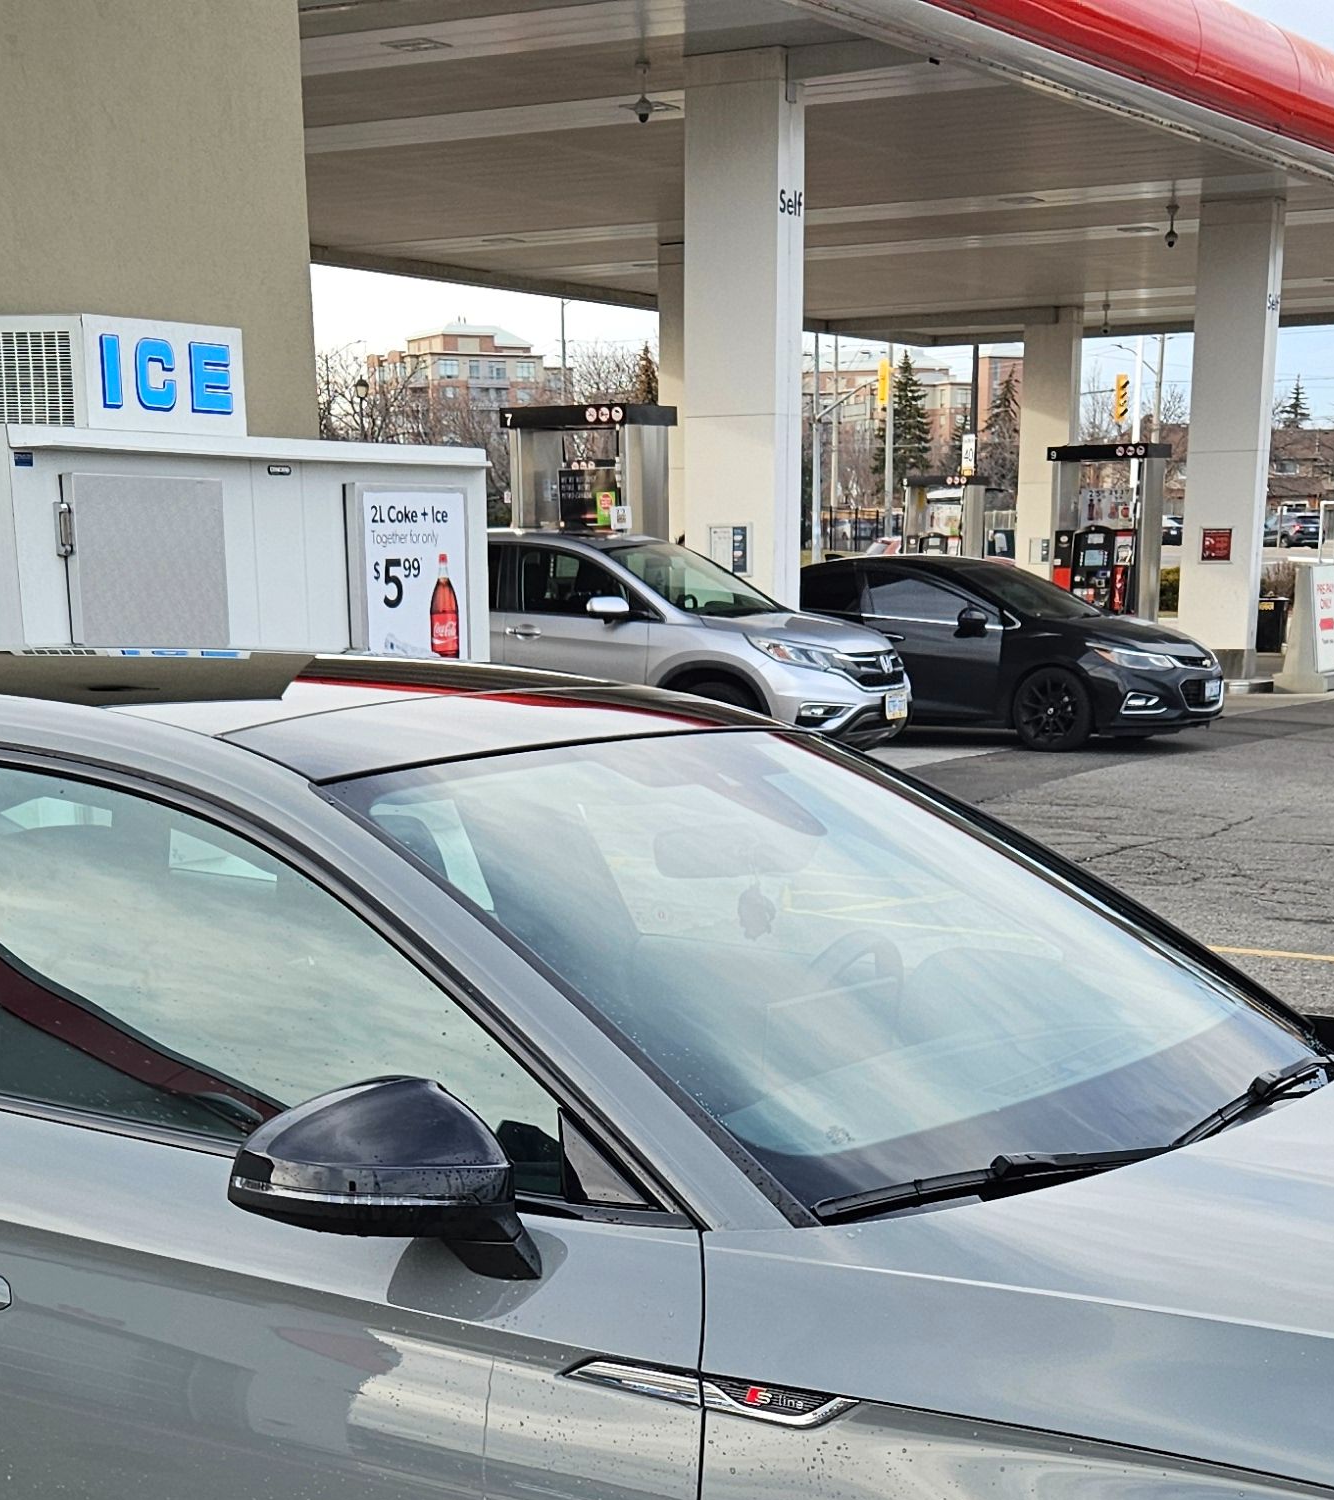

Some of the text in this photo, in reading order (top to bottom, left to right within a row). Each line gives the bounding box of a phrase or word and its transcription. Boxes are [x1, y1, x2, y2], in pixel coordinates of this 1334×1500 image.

[779, 188, 803, 217] Self
[98, 333, 234, 416] ICE
[504, 413, 513, 426] 7
[1050, 450, 1057, 460] 9
[371, 505, 449, 524] 2L Coke + Ice
[371, 529, 439, 548] Together for only
[777, 1393, 805, 1410] line
